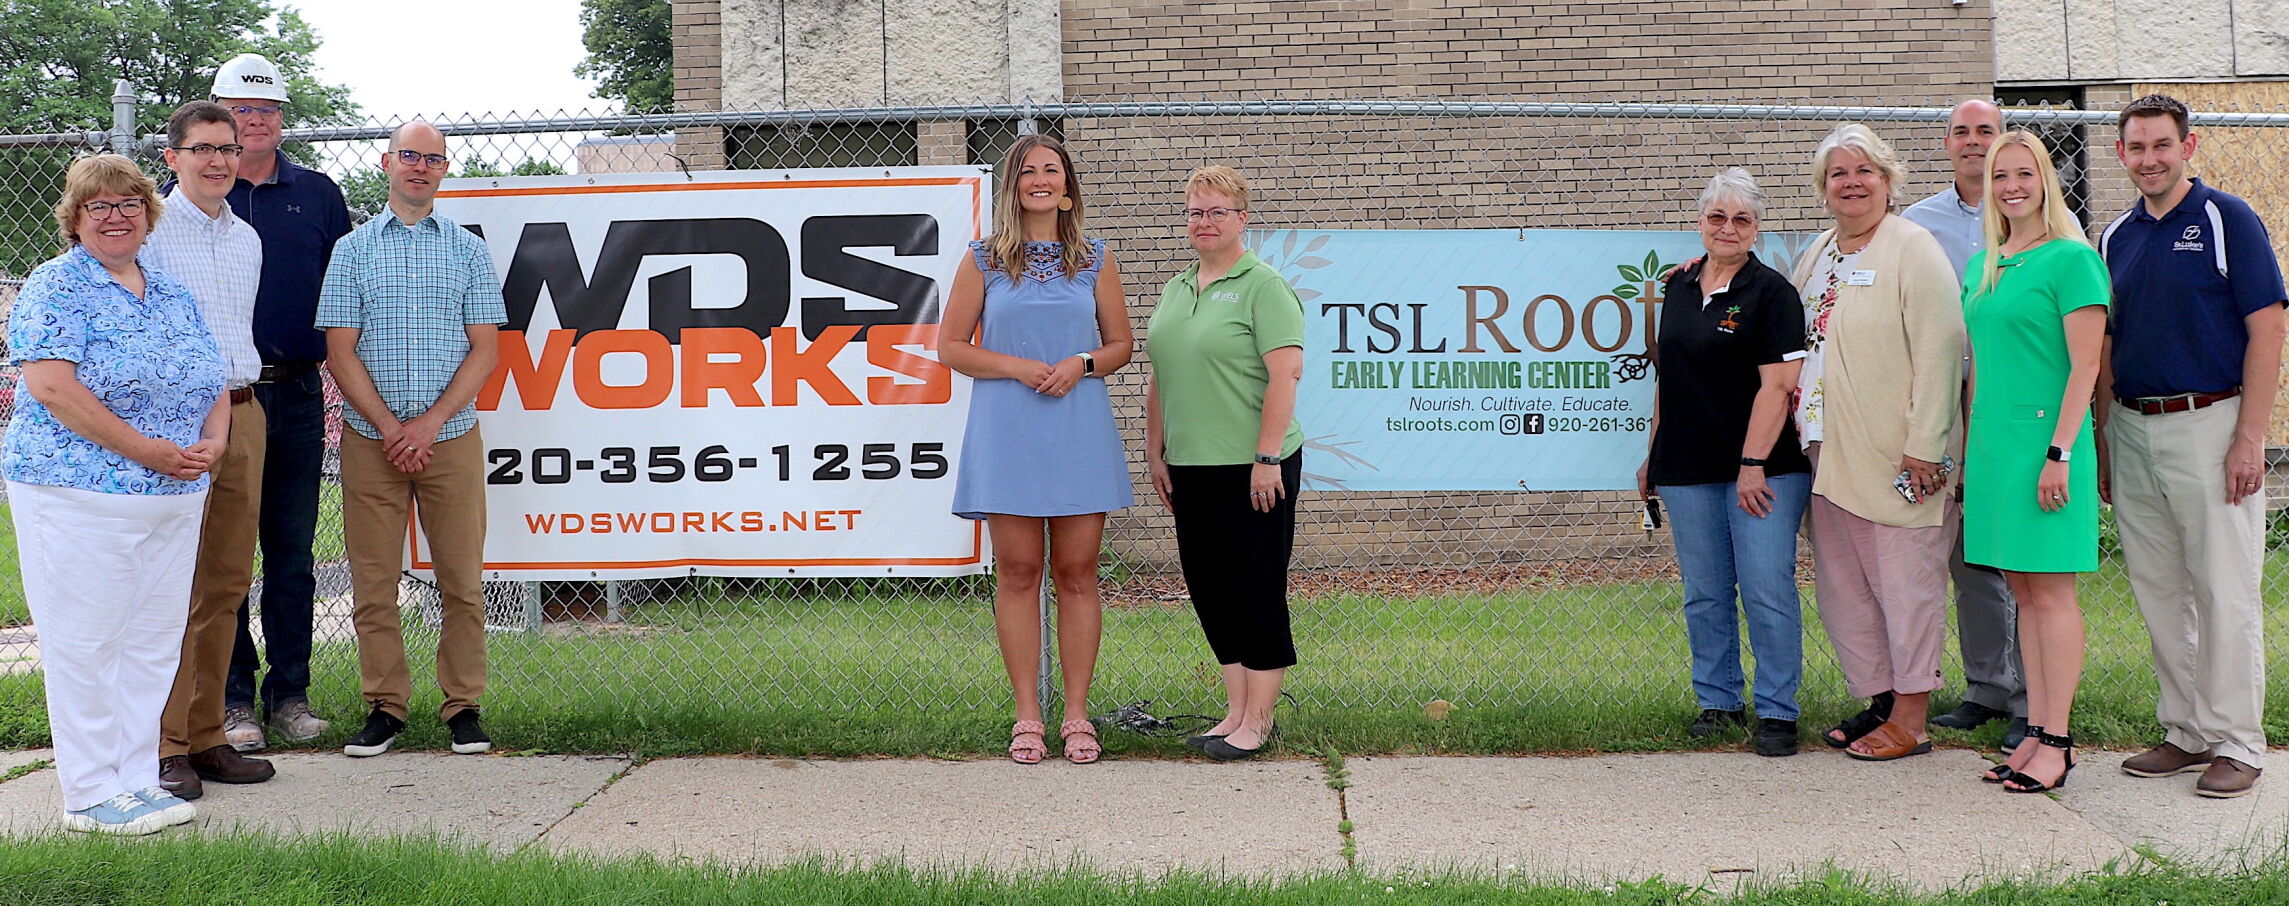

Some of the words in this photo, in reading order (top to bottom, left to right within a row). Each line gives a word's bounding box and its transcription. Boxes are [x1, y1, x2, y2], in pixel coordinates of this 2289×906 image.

[241, 75, 274, 85] WDS
[460, 213, 939, 347] WDS
[1321, 302, 1447, 355] TSL
[1457, 281, 1664, 358] Root
[475, 324, 952, 411] WORKS
[1331, 361, 1404, 390] EARLY
[1412, 361, 1522, 390] LEARNING
[1528, 361, 1611, 390] CENTER
[1408, 396, 1475, 412] Nourish.
[1480, 396, 1556, 412] Cultivate.
[1561, 396, 1633, 412] Educate.
[1386, 416, 1495, 433] tslroots.com
[1548, 417, 1653, 432] 920-261-361
[487, 442, 949, 485] 20-356-1255
[525, 509, 862, 535] WDSWORKS.NET
